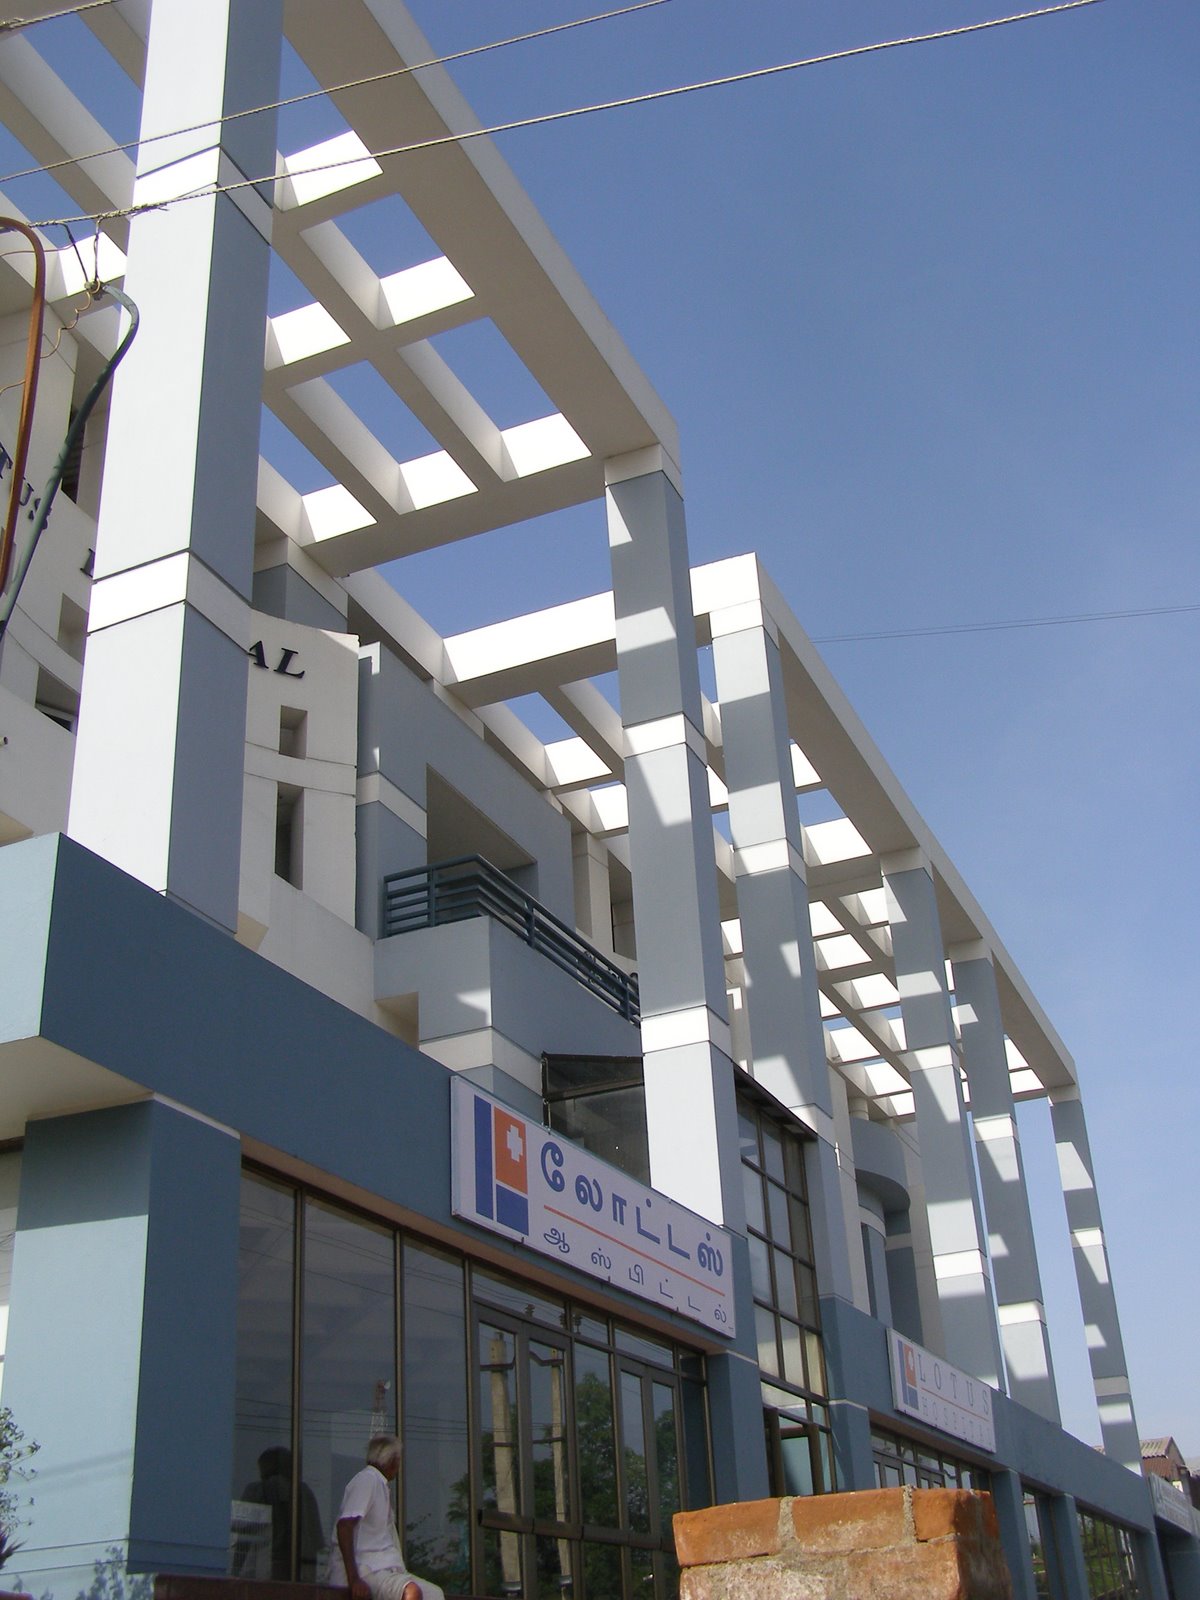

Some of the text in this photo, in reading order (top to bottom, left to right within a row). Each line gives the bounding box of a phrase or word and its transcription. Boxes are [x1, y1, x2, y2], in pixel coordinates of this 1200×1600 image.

[540, 1141, 724, 1277] லோட்டஸ்
[543, 1225, 727, 1324] ஆஸ்பிட்டல்
[917, 1353, 989, 1416] LOTUS
